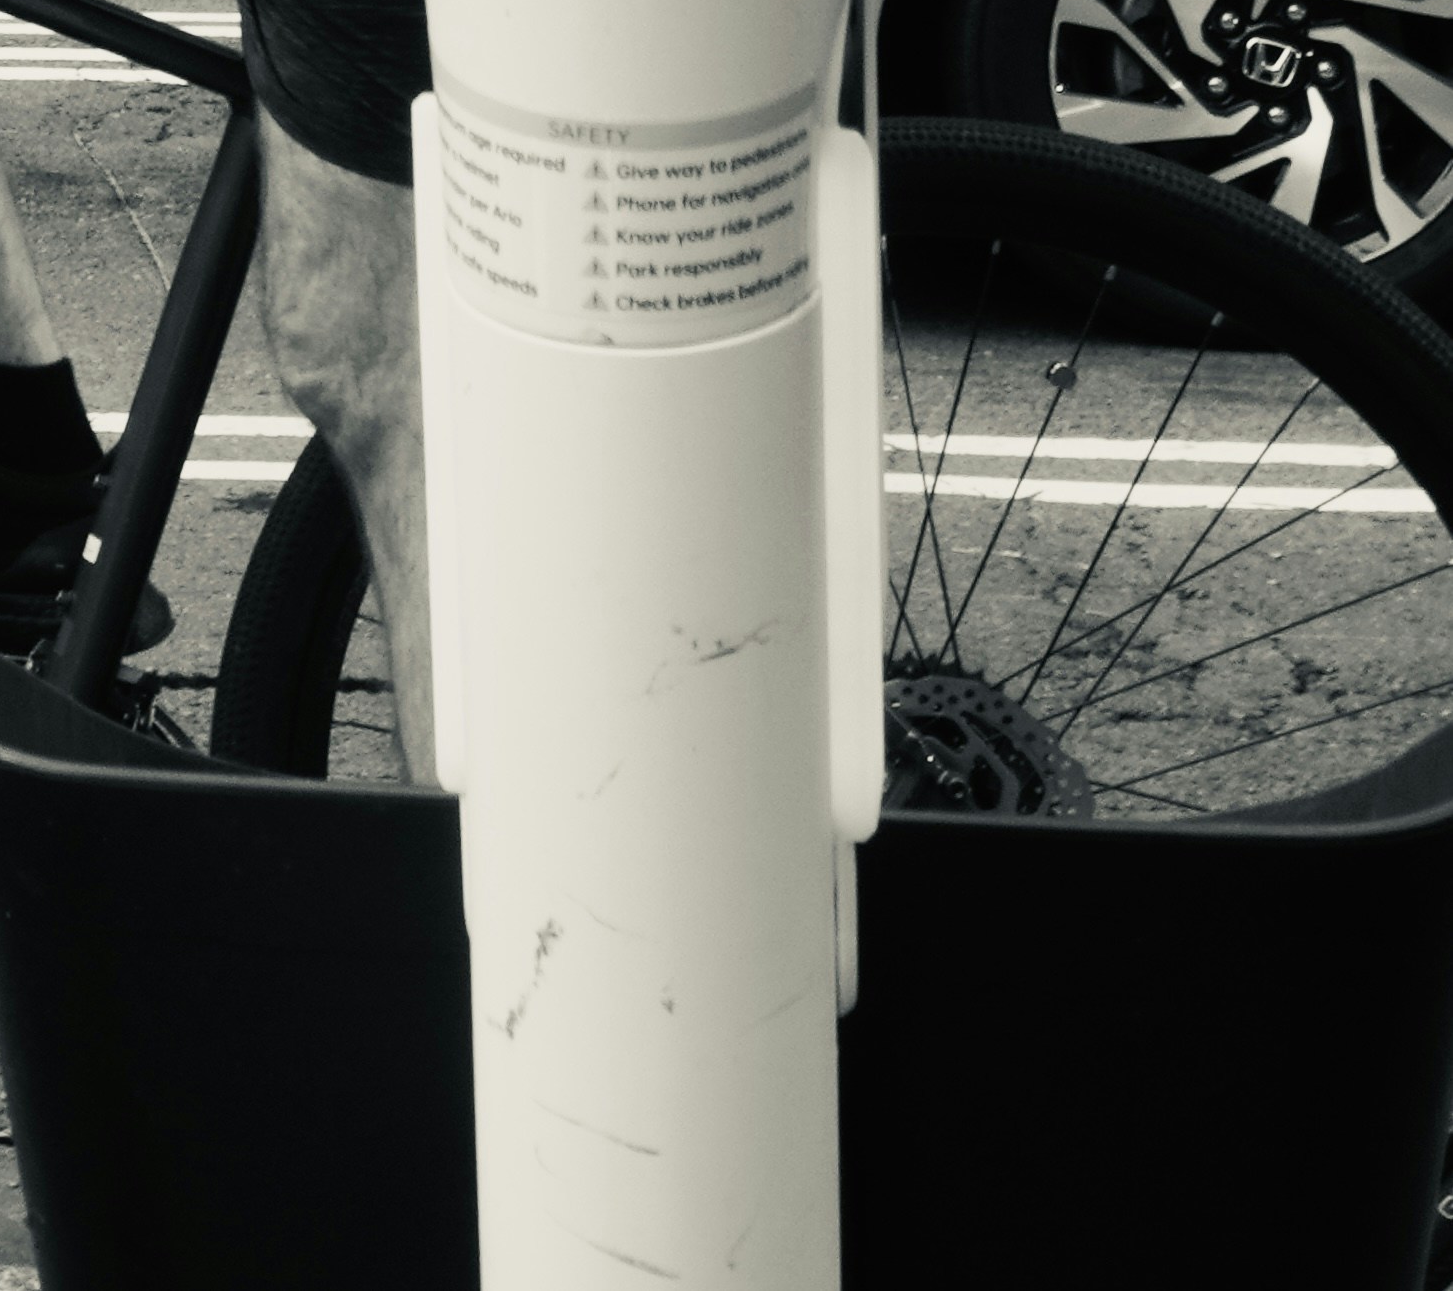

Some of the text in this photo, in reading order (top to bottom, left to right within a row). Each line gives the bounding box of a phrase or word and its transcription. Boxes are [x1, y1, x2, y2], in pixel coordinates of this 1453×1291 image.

[547, 121, 630, 146] SAFETY
[495, 142, 567, 174] required
[617, 163, 660, 180] Give
[665, 162, 703, 180] way
[710, 159, 727, 174] to
[617, 194, 676, 211] Phone
[682, 192, 708, 209] for
[493, 204, 523, 229] Ario
[617, 228, 671, 245] Know
[676, 226, 717, 248] your
[721, 217, 754, 237] ride
[617, 245, 763, 278] Park responsibly
[486, 267, 539, 298] speeds
[617, 295, 671, 312] Check
[677, 288, 737, 310] brakes
